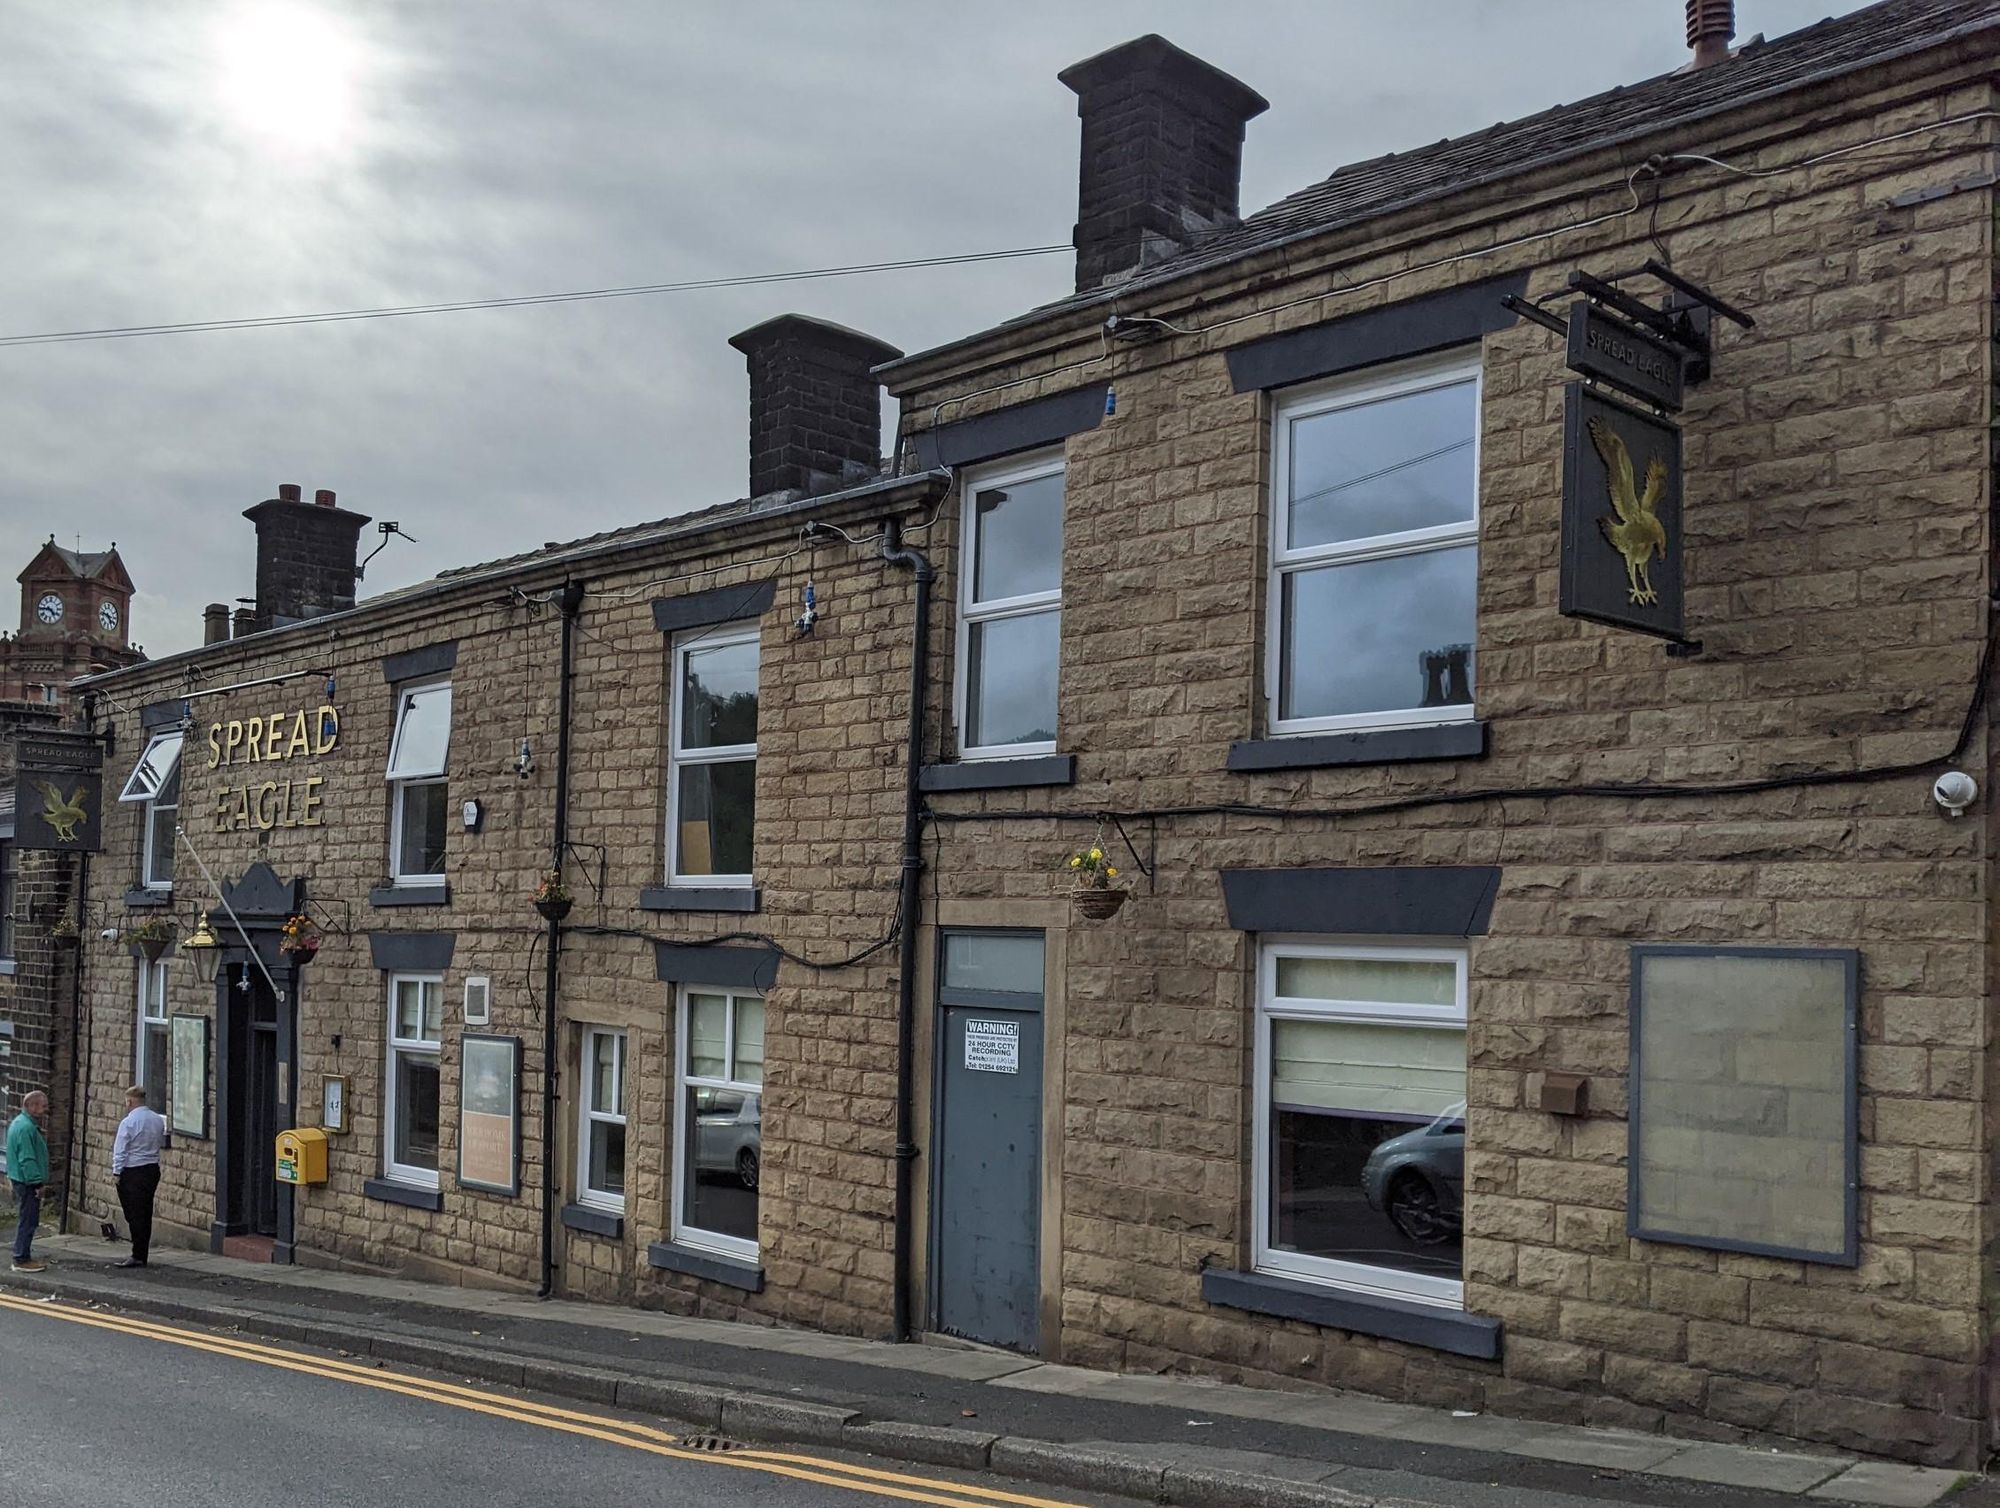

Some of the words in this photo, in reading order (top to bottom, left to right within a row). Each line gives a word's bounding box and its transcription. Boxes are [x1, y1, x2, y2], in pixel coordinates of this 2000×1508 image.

[1589, 330, 1634, 364] SPREAD
[208, 705, 338, 769] SPREAD
[215, 776, 323, 832] EAGLE
[969, 1021, 1017, 1035] WARNING!
[972, 1047, 1012, 1056] RECORDING
[997, 1042, 1016, 1050] CCTV
